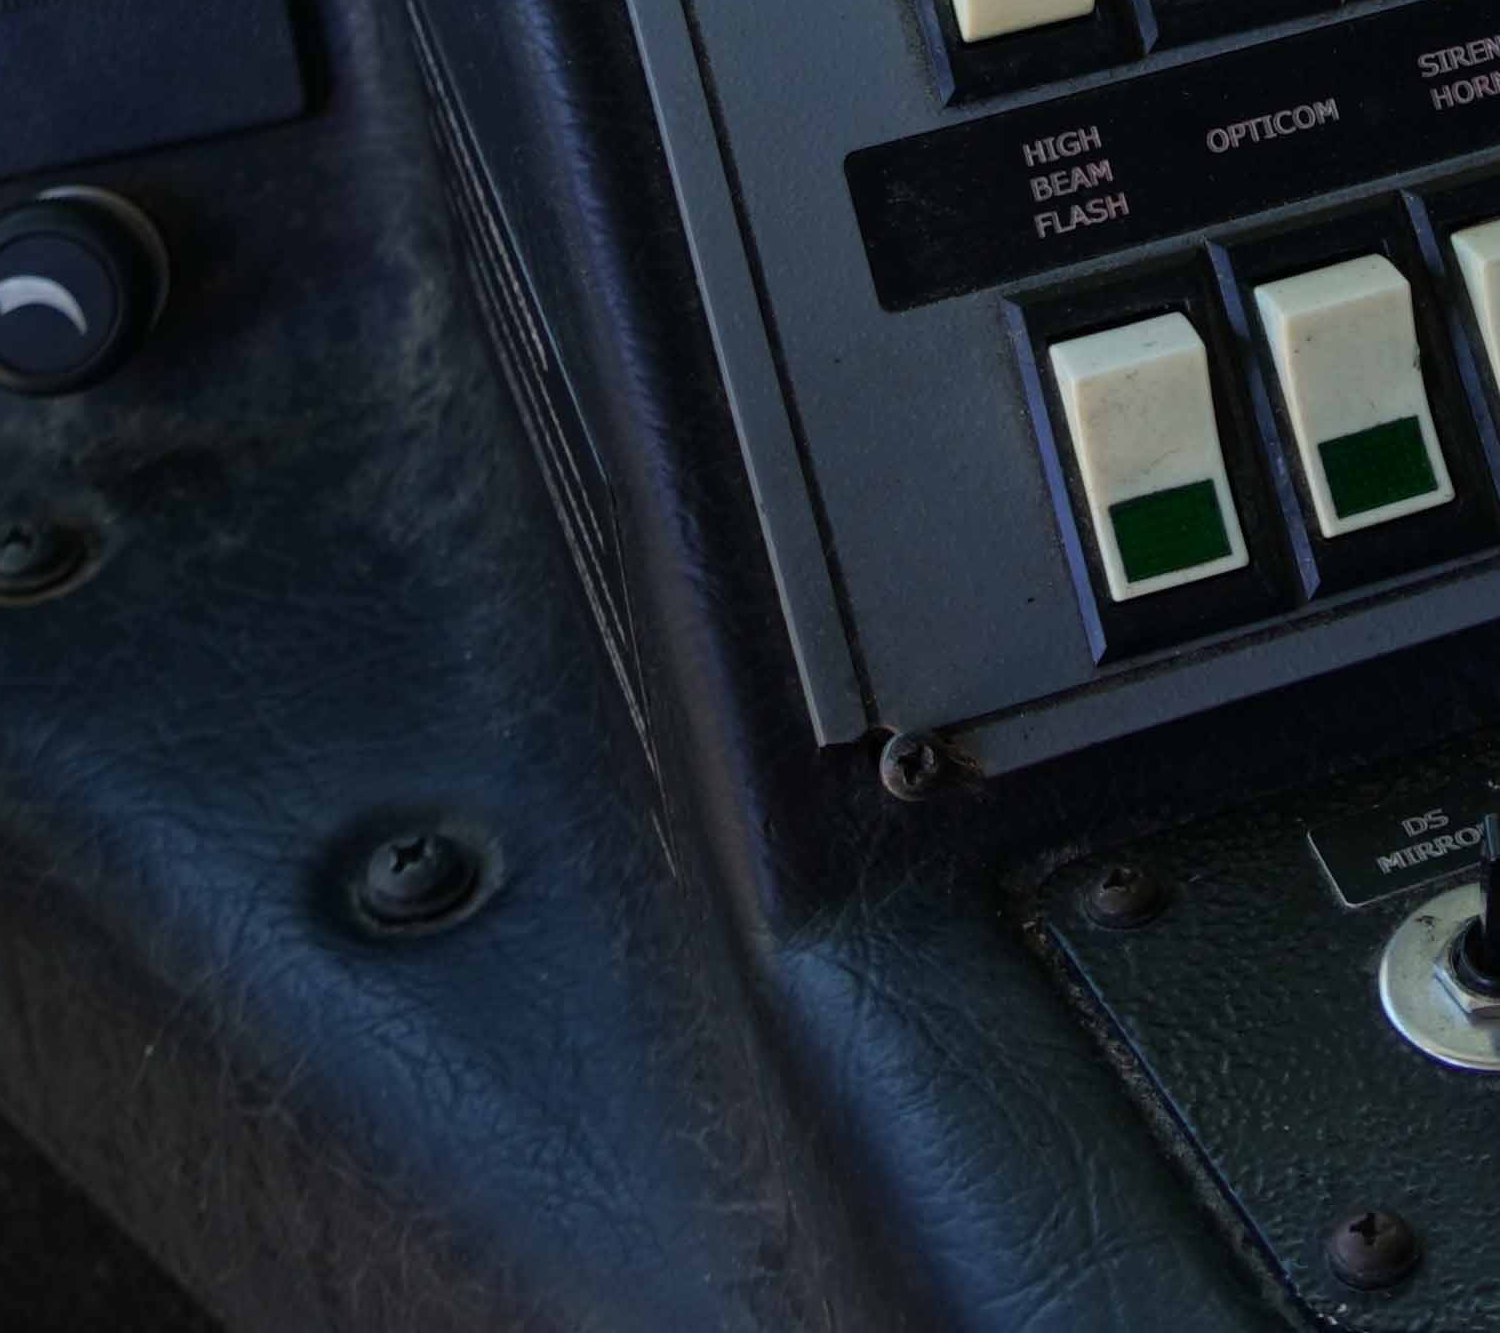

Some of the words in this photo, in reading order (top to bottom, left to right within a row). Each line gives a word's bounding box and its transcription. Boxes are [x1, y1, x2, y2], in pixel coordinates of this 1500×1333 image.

[1022, 125, 1102, 168] HIGH
[1205, 98, 1341, 155] OPTICOM
[1029, 159, 1115, 204] BEAM
[1033, 192, 1131, 239] FLASH
[1401, 807, 1451, 839] DS
[1375, 821, 1488, 876] MIRRO
